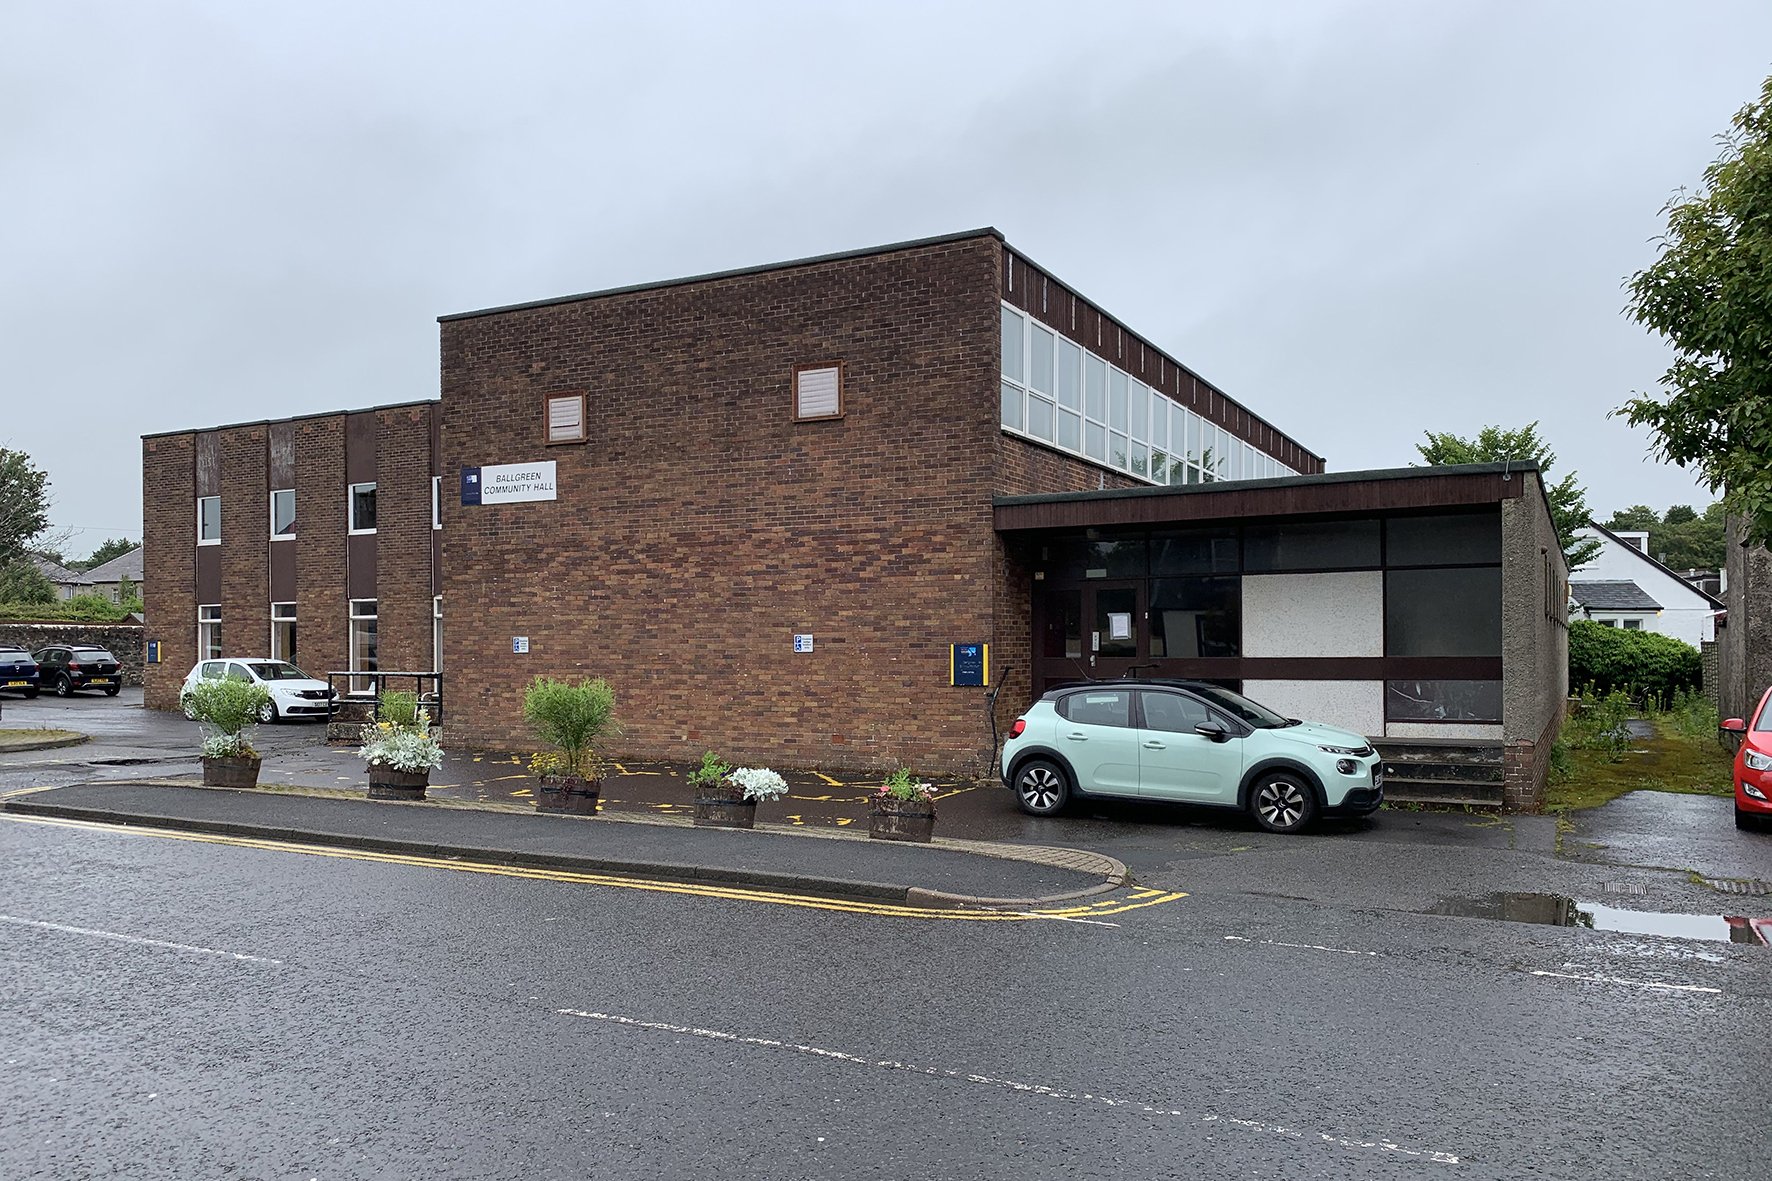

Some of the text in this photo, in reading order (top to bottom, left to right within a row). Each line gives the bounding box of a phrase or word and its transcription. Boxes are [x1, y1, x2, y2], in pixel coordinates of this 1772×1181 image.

[496, 472, 541, 483] BALLGREEN
[484, 483, 554, 495] COMMUNITY HALL
